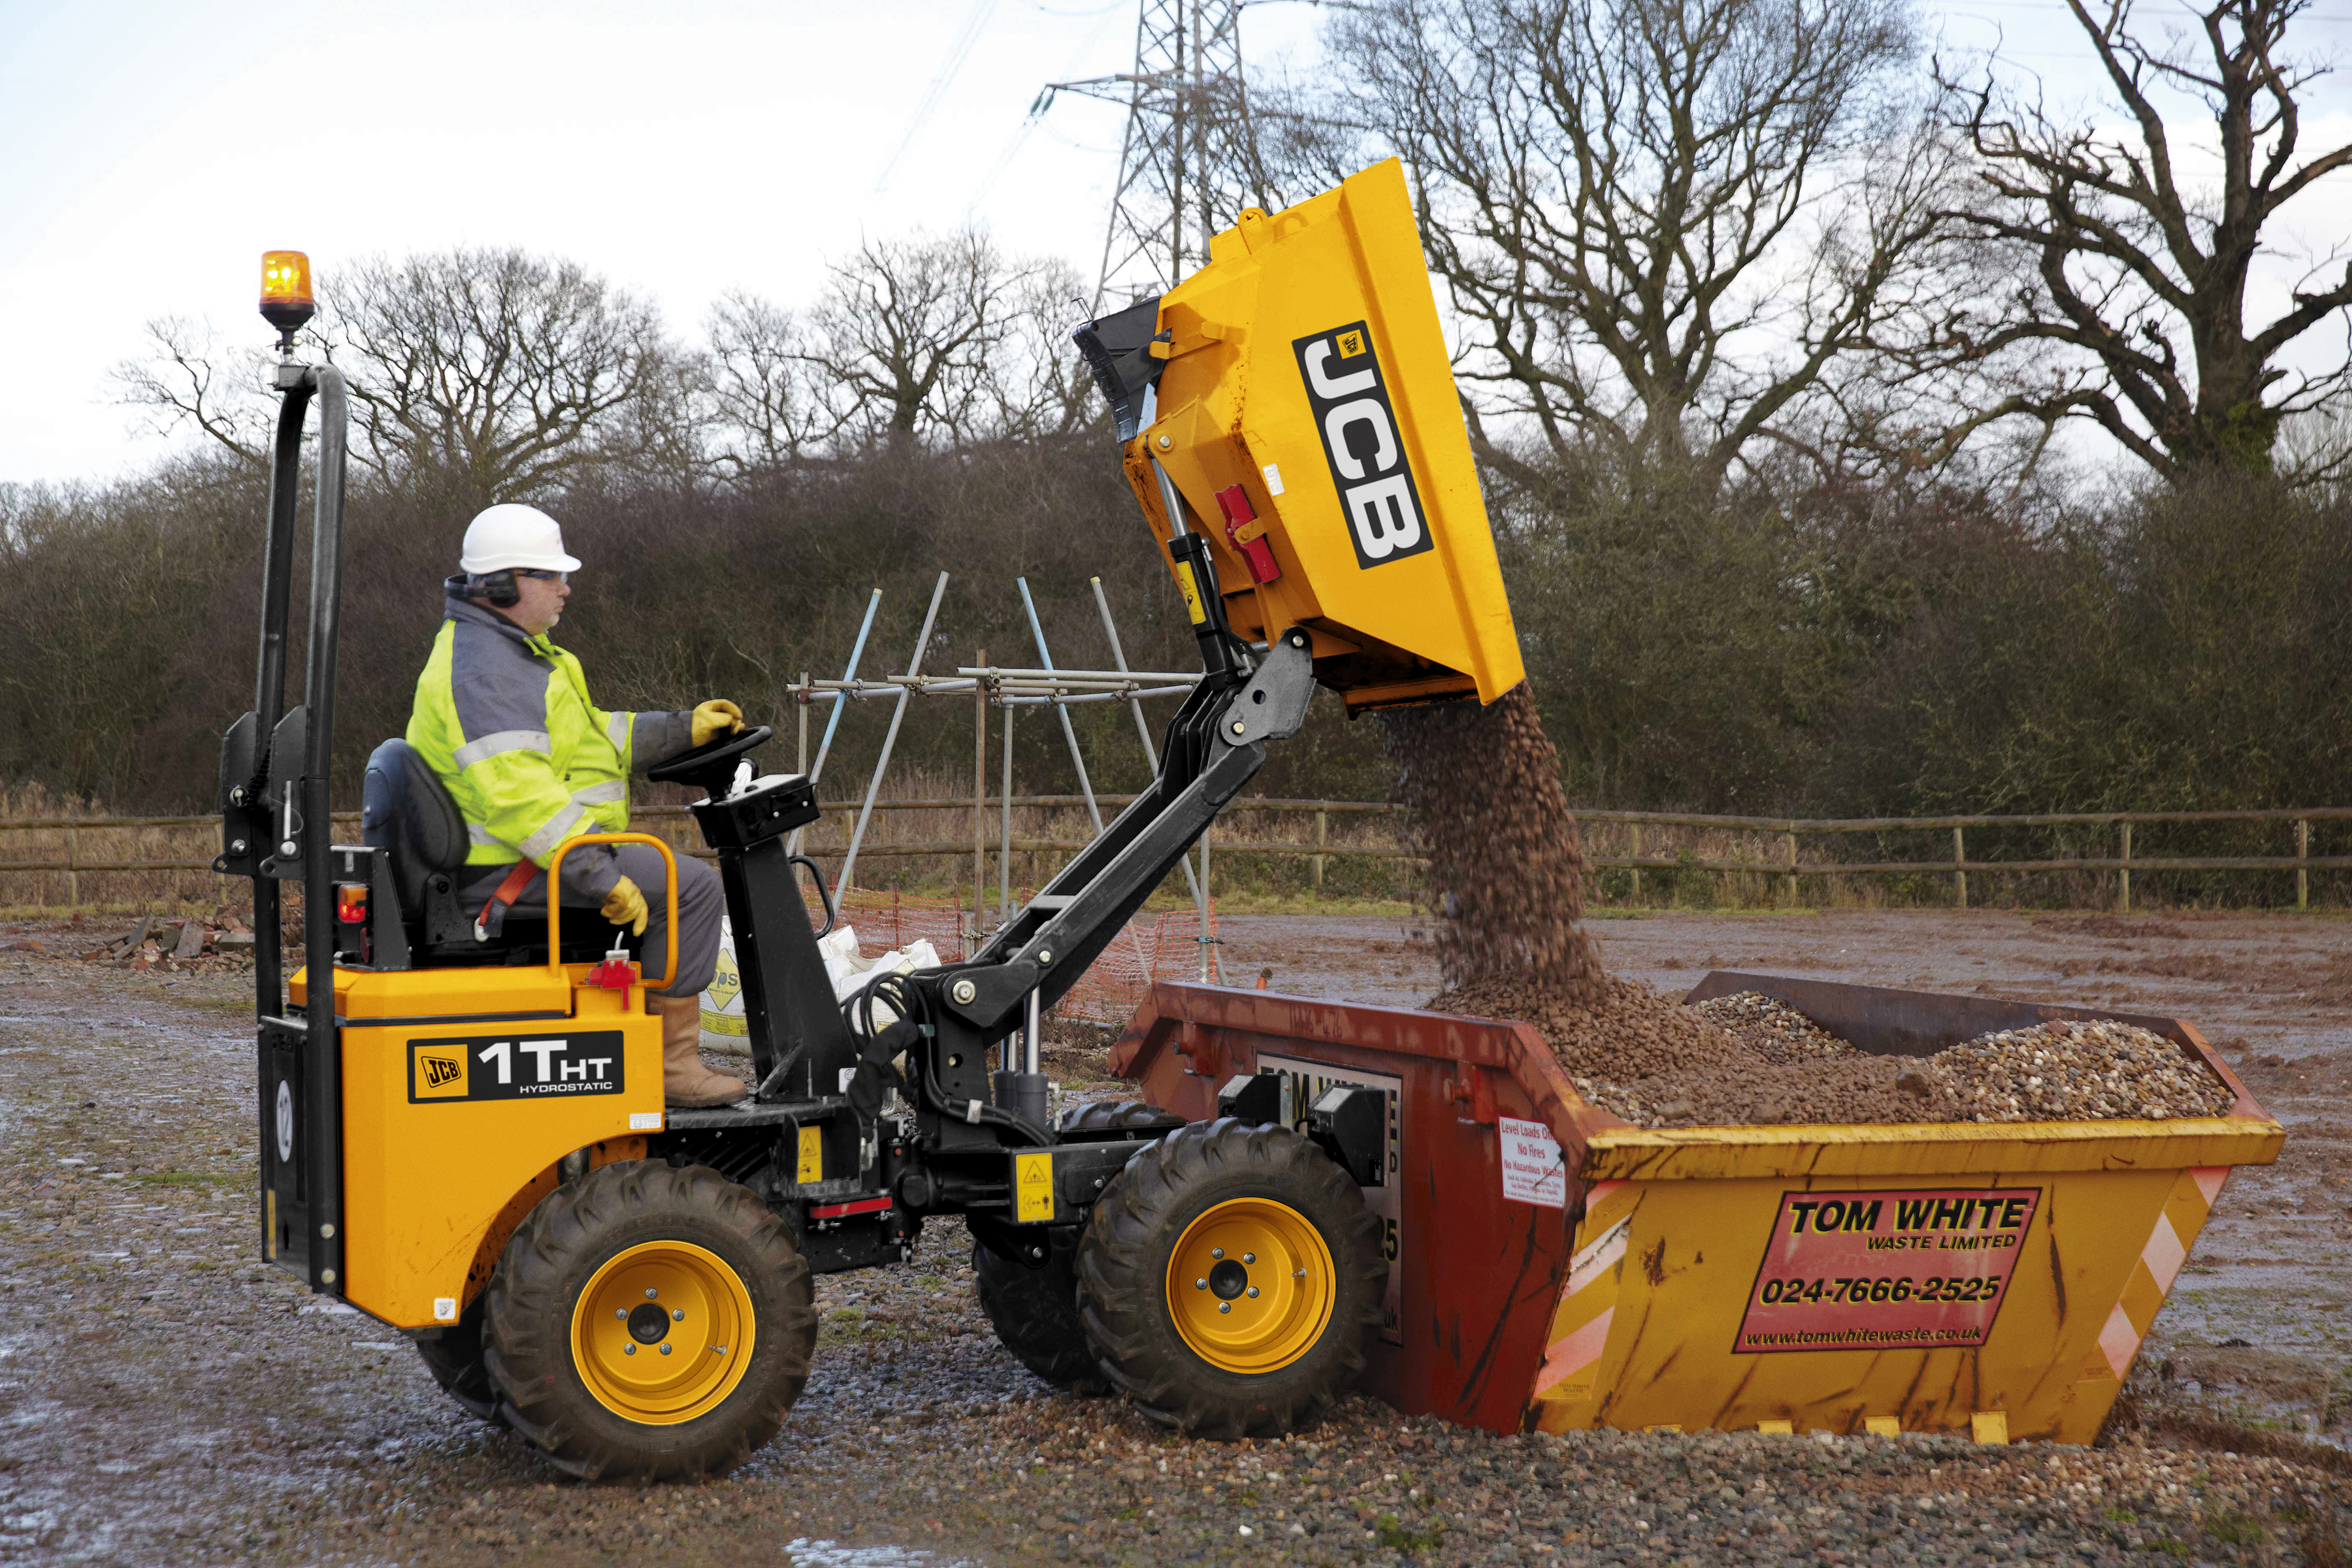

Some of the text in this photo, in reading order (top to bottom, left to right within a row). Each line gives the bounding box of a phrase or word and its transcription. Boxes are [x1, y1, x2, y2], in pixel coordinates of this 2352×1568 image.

[1344, 336, 1358, 353] JCB
[1304, 338, 1421, 559] JCB
[428, 1059, 459, 1085] JCB
[520, 1081, 613, 1094] HYDROSTATIC
[1501, 1120, 1518, 1135] Level
[1520, 1122, 1540, 1139] Loads
[1517, 1142, 1545, 1159] No Fires
[1504, 1159, 1511, 1169] No
[1512, 1160, 1541, 1175] Hazardous
[1788, 1197, 2029, 1236] TOM WHITE
[1866, 1233, 2017, 1251] WASTE LIMITED
[1759, 1275, 2002, 1306] 024-7666-2525
[1744, 1326, 1982, 1346] www.tomwhitewaste.co.uk
